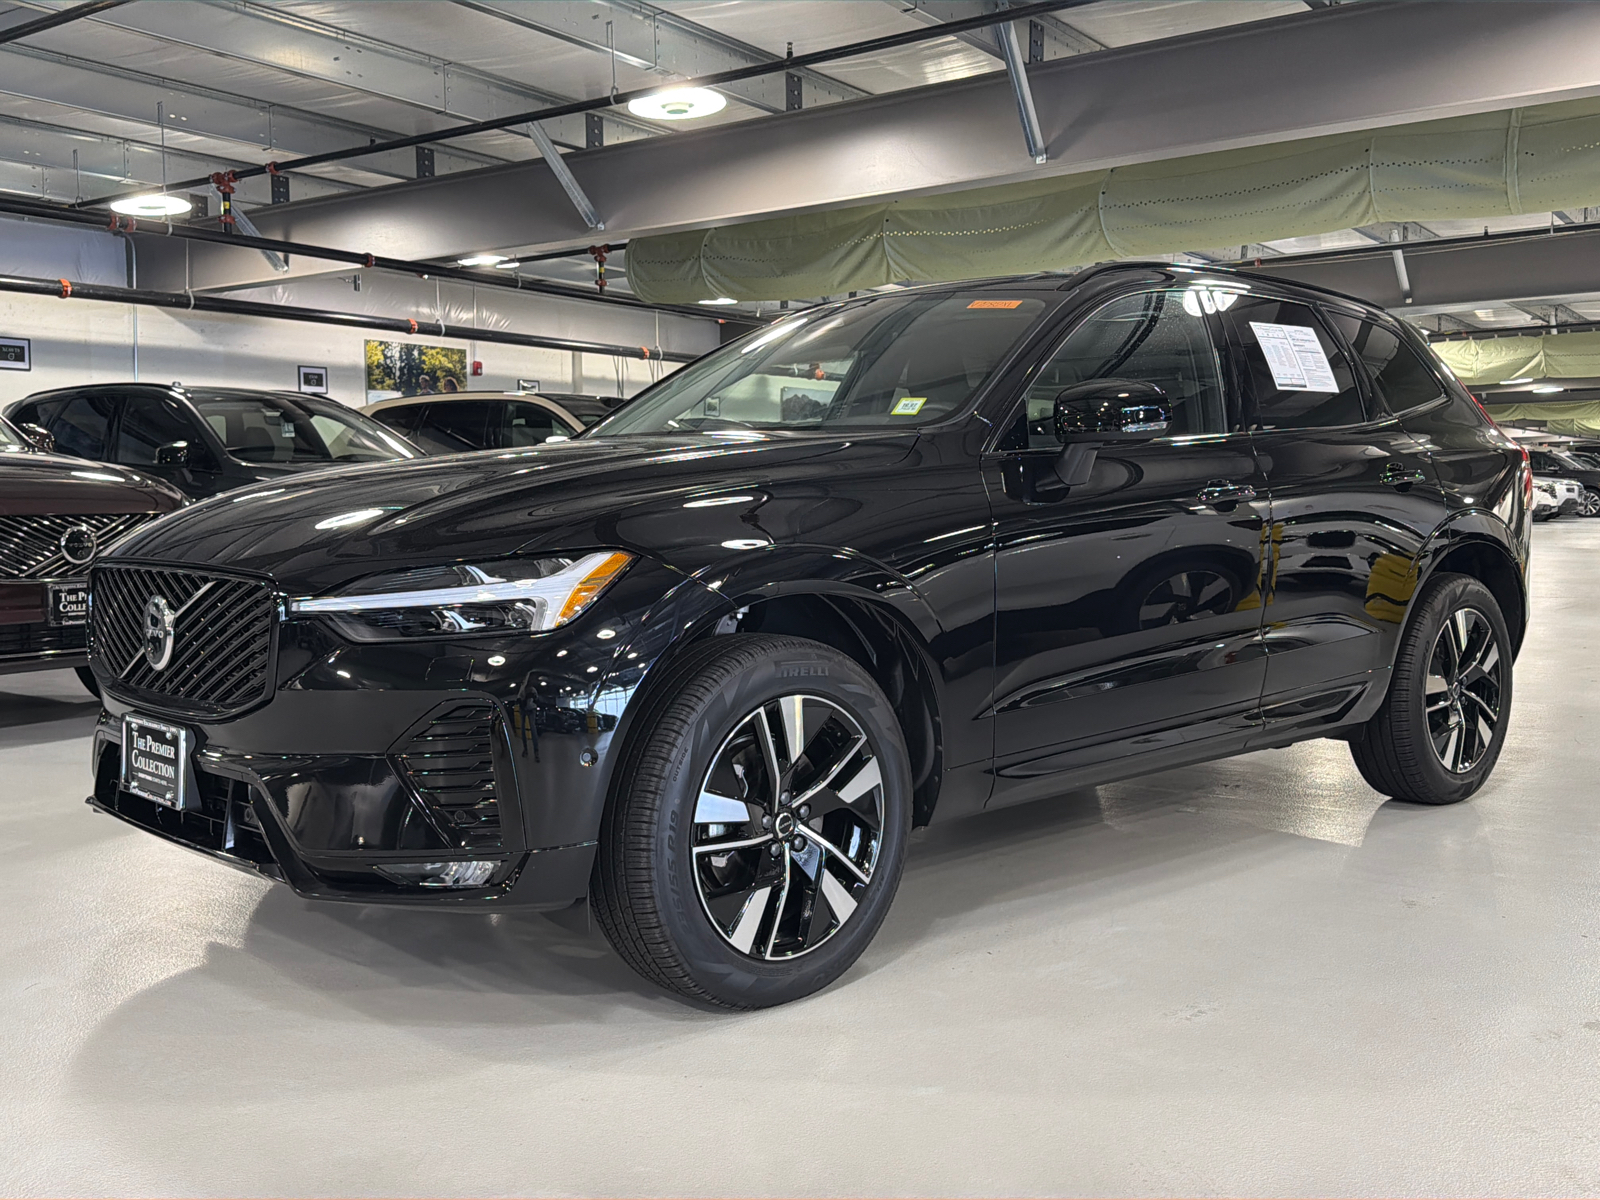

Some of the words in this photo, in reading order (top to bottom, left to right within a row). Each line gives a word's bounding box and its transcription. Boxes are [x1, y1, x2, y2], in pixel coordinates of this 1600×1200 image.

[59, 592, 77, 602] THE
[774, 658, 829, 679] PIRELLI
[132, 731, 146, 751] THE
[146, 735, 175, 759] PREMIER
[132, 750, 175, 779] COLLECTION
[673, 746, 689, 782] OUTSIDE
[667, 809, 679, 853] R19
